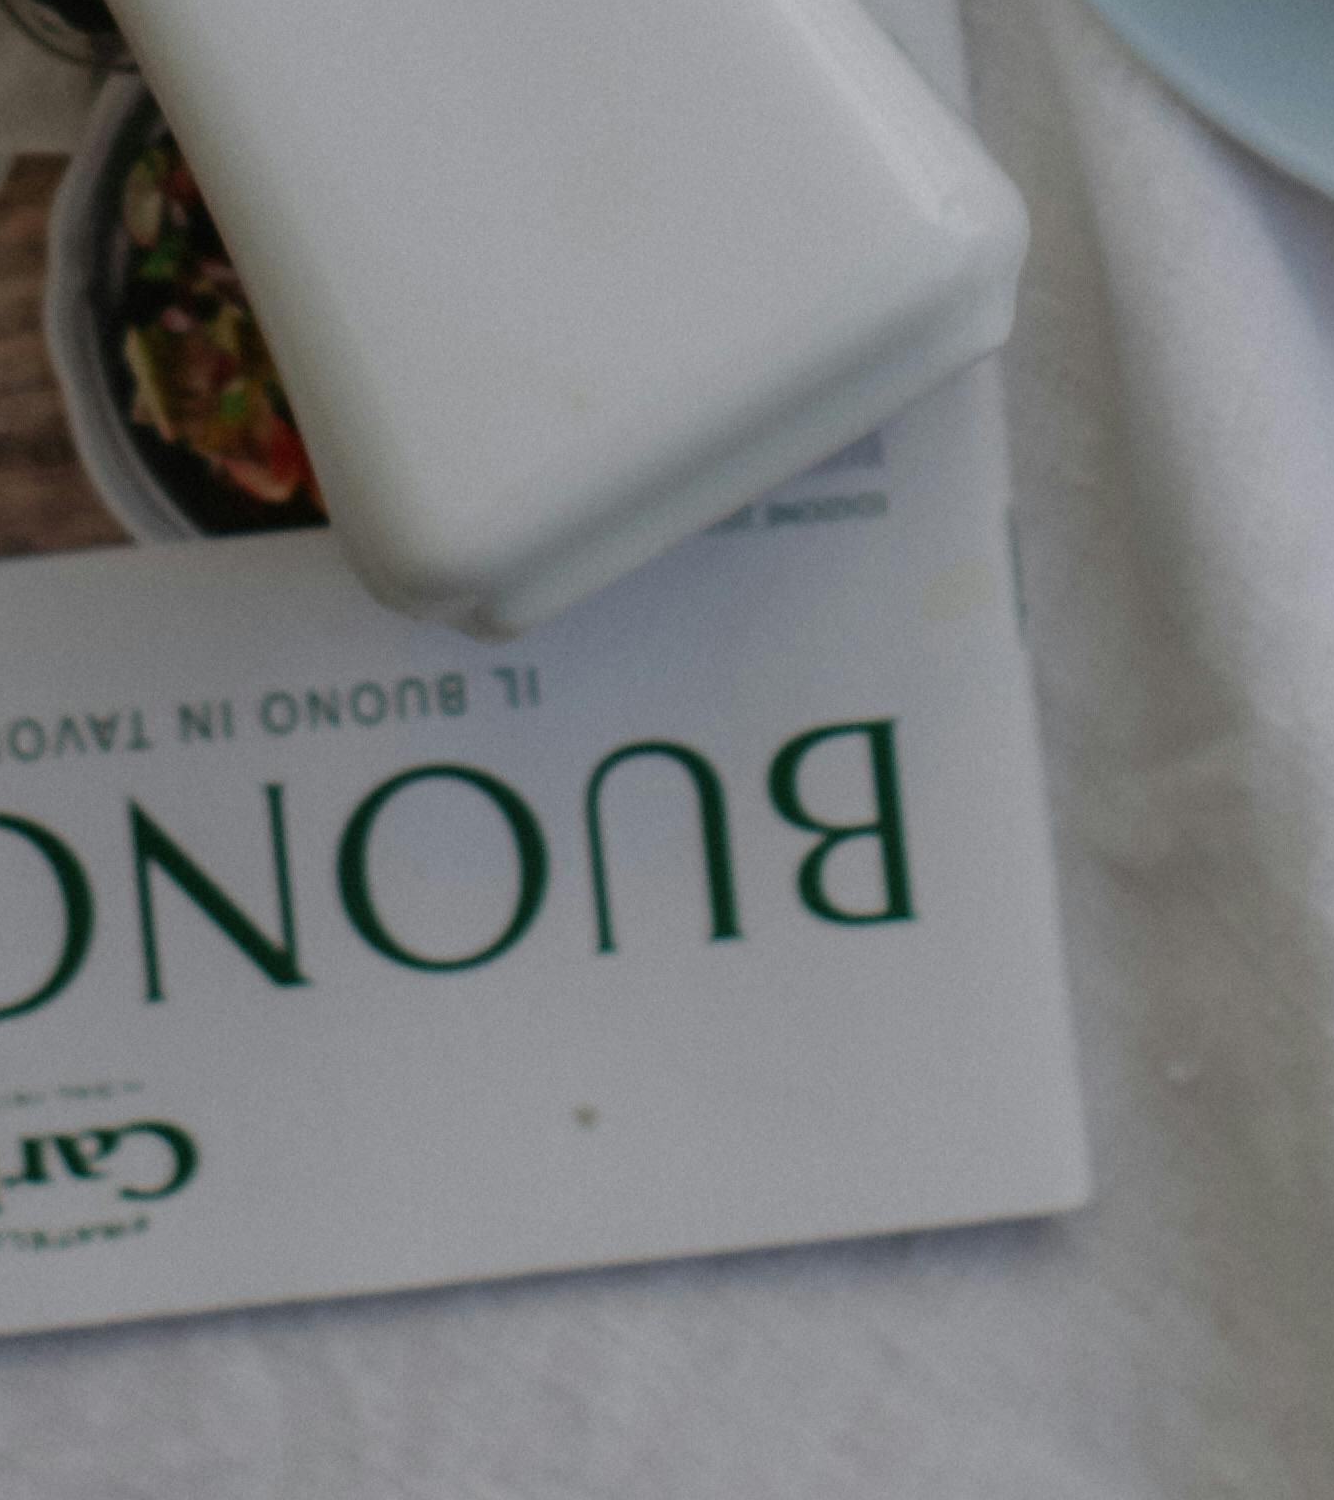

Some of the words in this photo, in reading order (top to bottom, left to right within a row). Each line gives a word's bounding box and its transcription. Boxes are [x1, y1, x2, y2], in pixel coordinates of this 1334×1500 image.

[259, 671, 468, 736] BUONO
[491, 663, 542, 710] IL
[174, 699, 235, 751] IN
